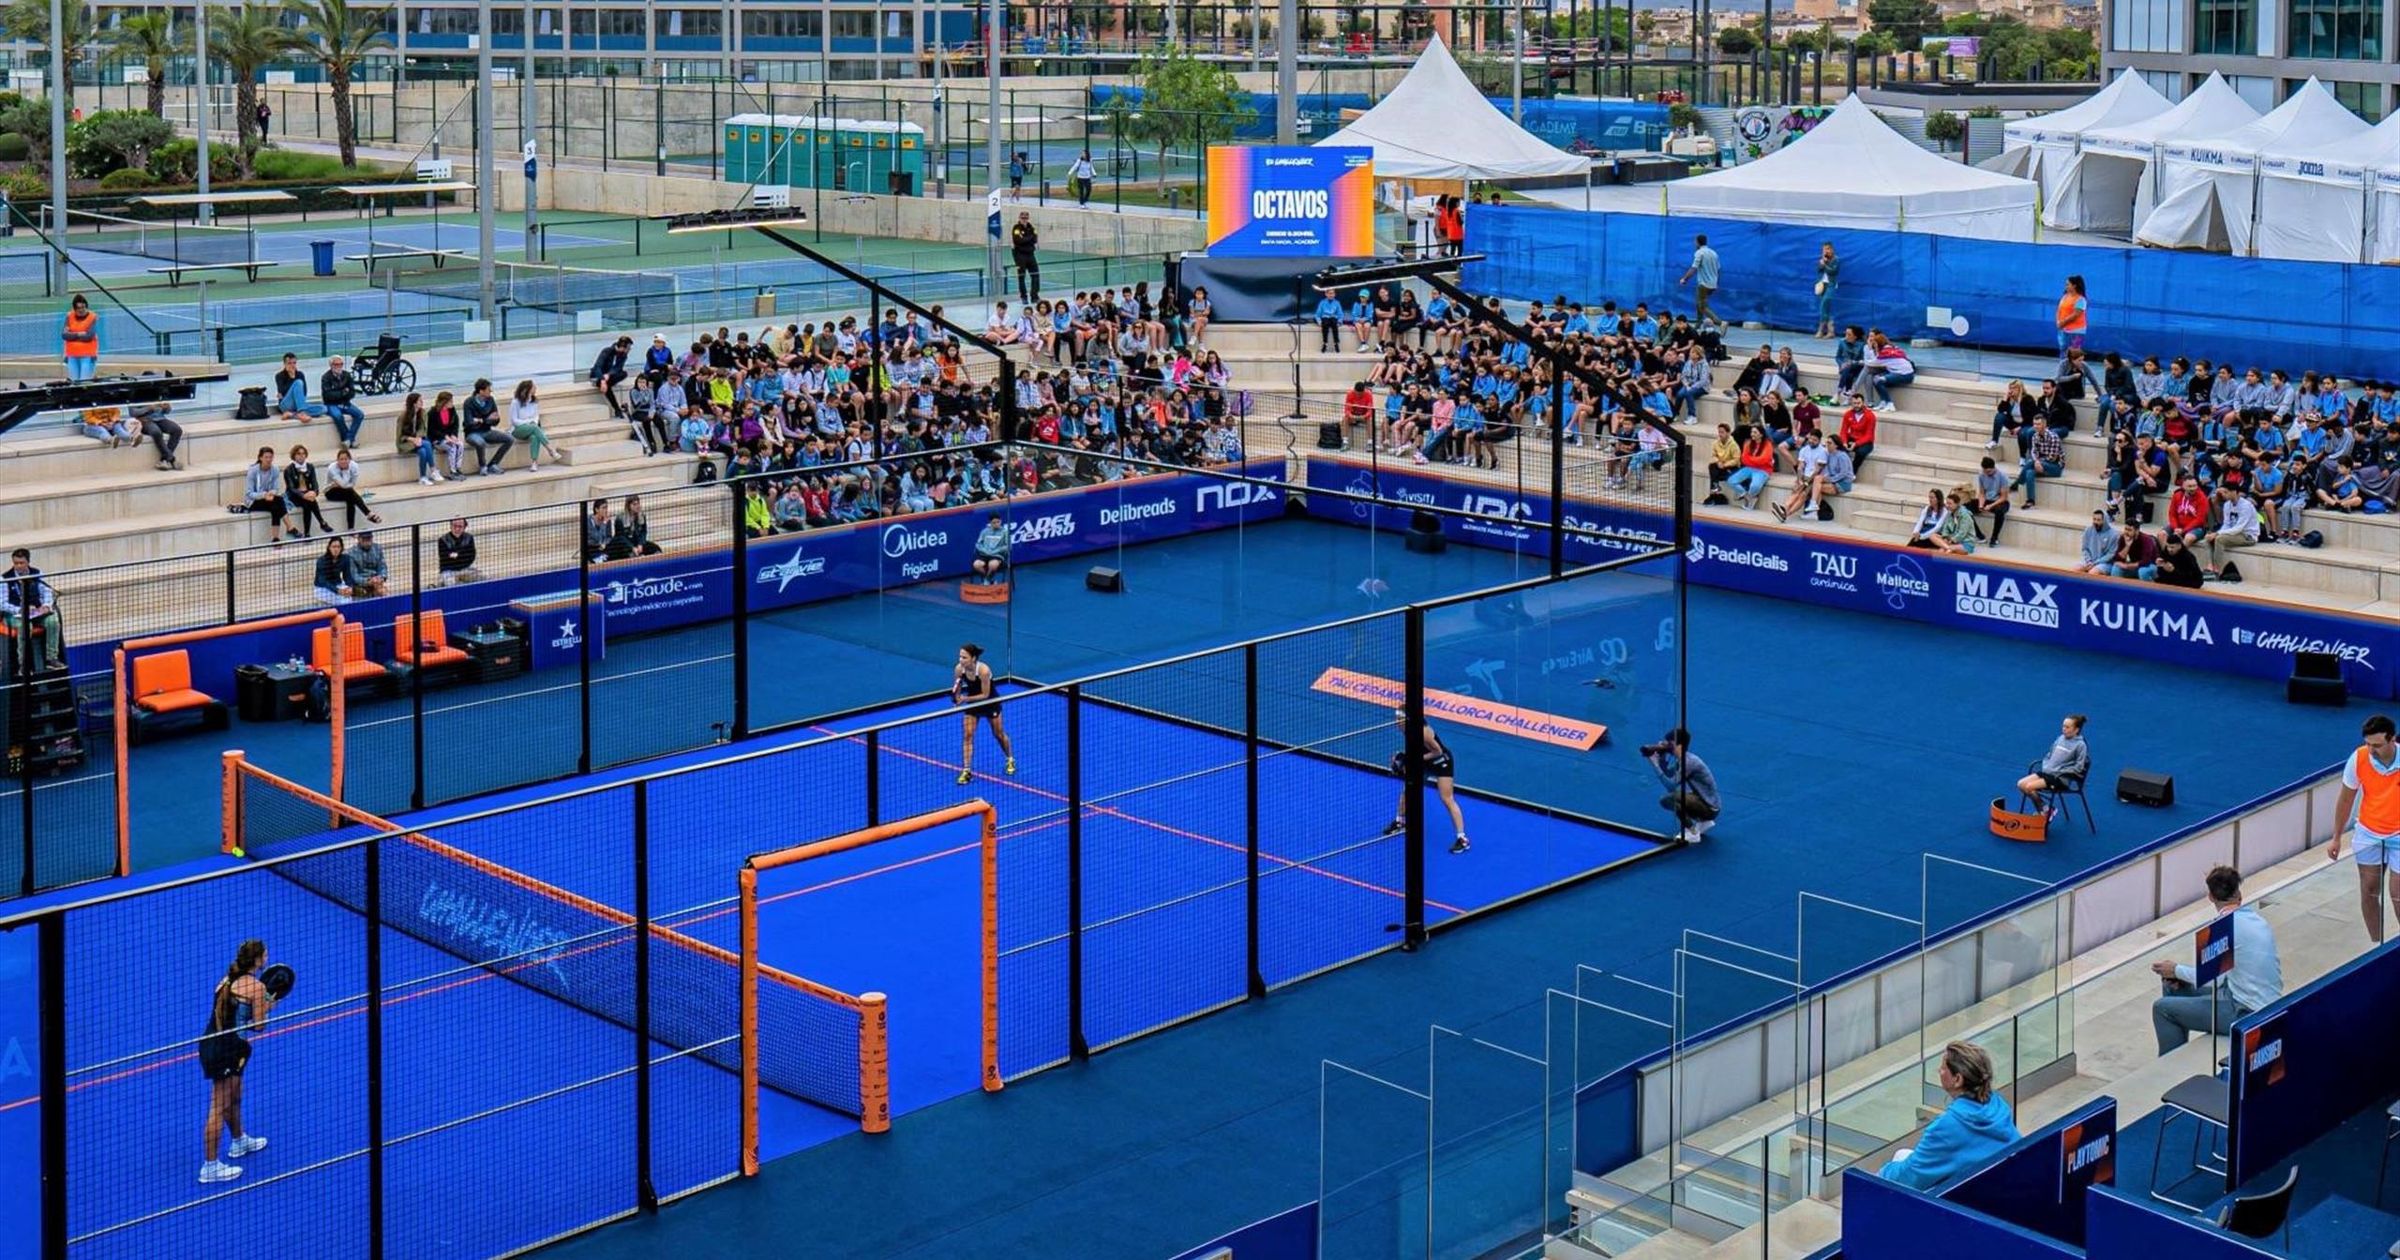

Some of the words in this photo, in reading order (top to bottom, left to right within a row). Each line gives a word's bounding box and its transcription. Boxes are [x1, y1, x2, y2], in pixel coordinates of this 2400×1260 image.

[2191, 148, 2223, 165] KUIKMA
[992, 198, 999, 206] 2
[1253, 190, 1328, 219] OCTAVOS
[1100, 498, 1176, 526] Delibreads
[894, 531, 947, 553] Midea
[1708, 545, 1789, 572] PadelGalis
[1810, 551, 1858, 579] TAU
[1877, 572, 1929, 592] Mallorca
[1956, 571, 2058, 608] MAX
[1957, 596, 2058, 626] COLCHON
[2080, 598, 2214, 644] KUIKMA
[2256, 631, 2375, 670] CHALLENGER
[1423, 696, 1494, 723] MALLORCA
[1495, 713, 1588, 742] CHALLENGER
[2249, 1038, 2282, 1072] TRANSMED
[2067, 1134, 2110, 1174] PLAYTOMIC
